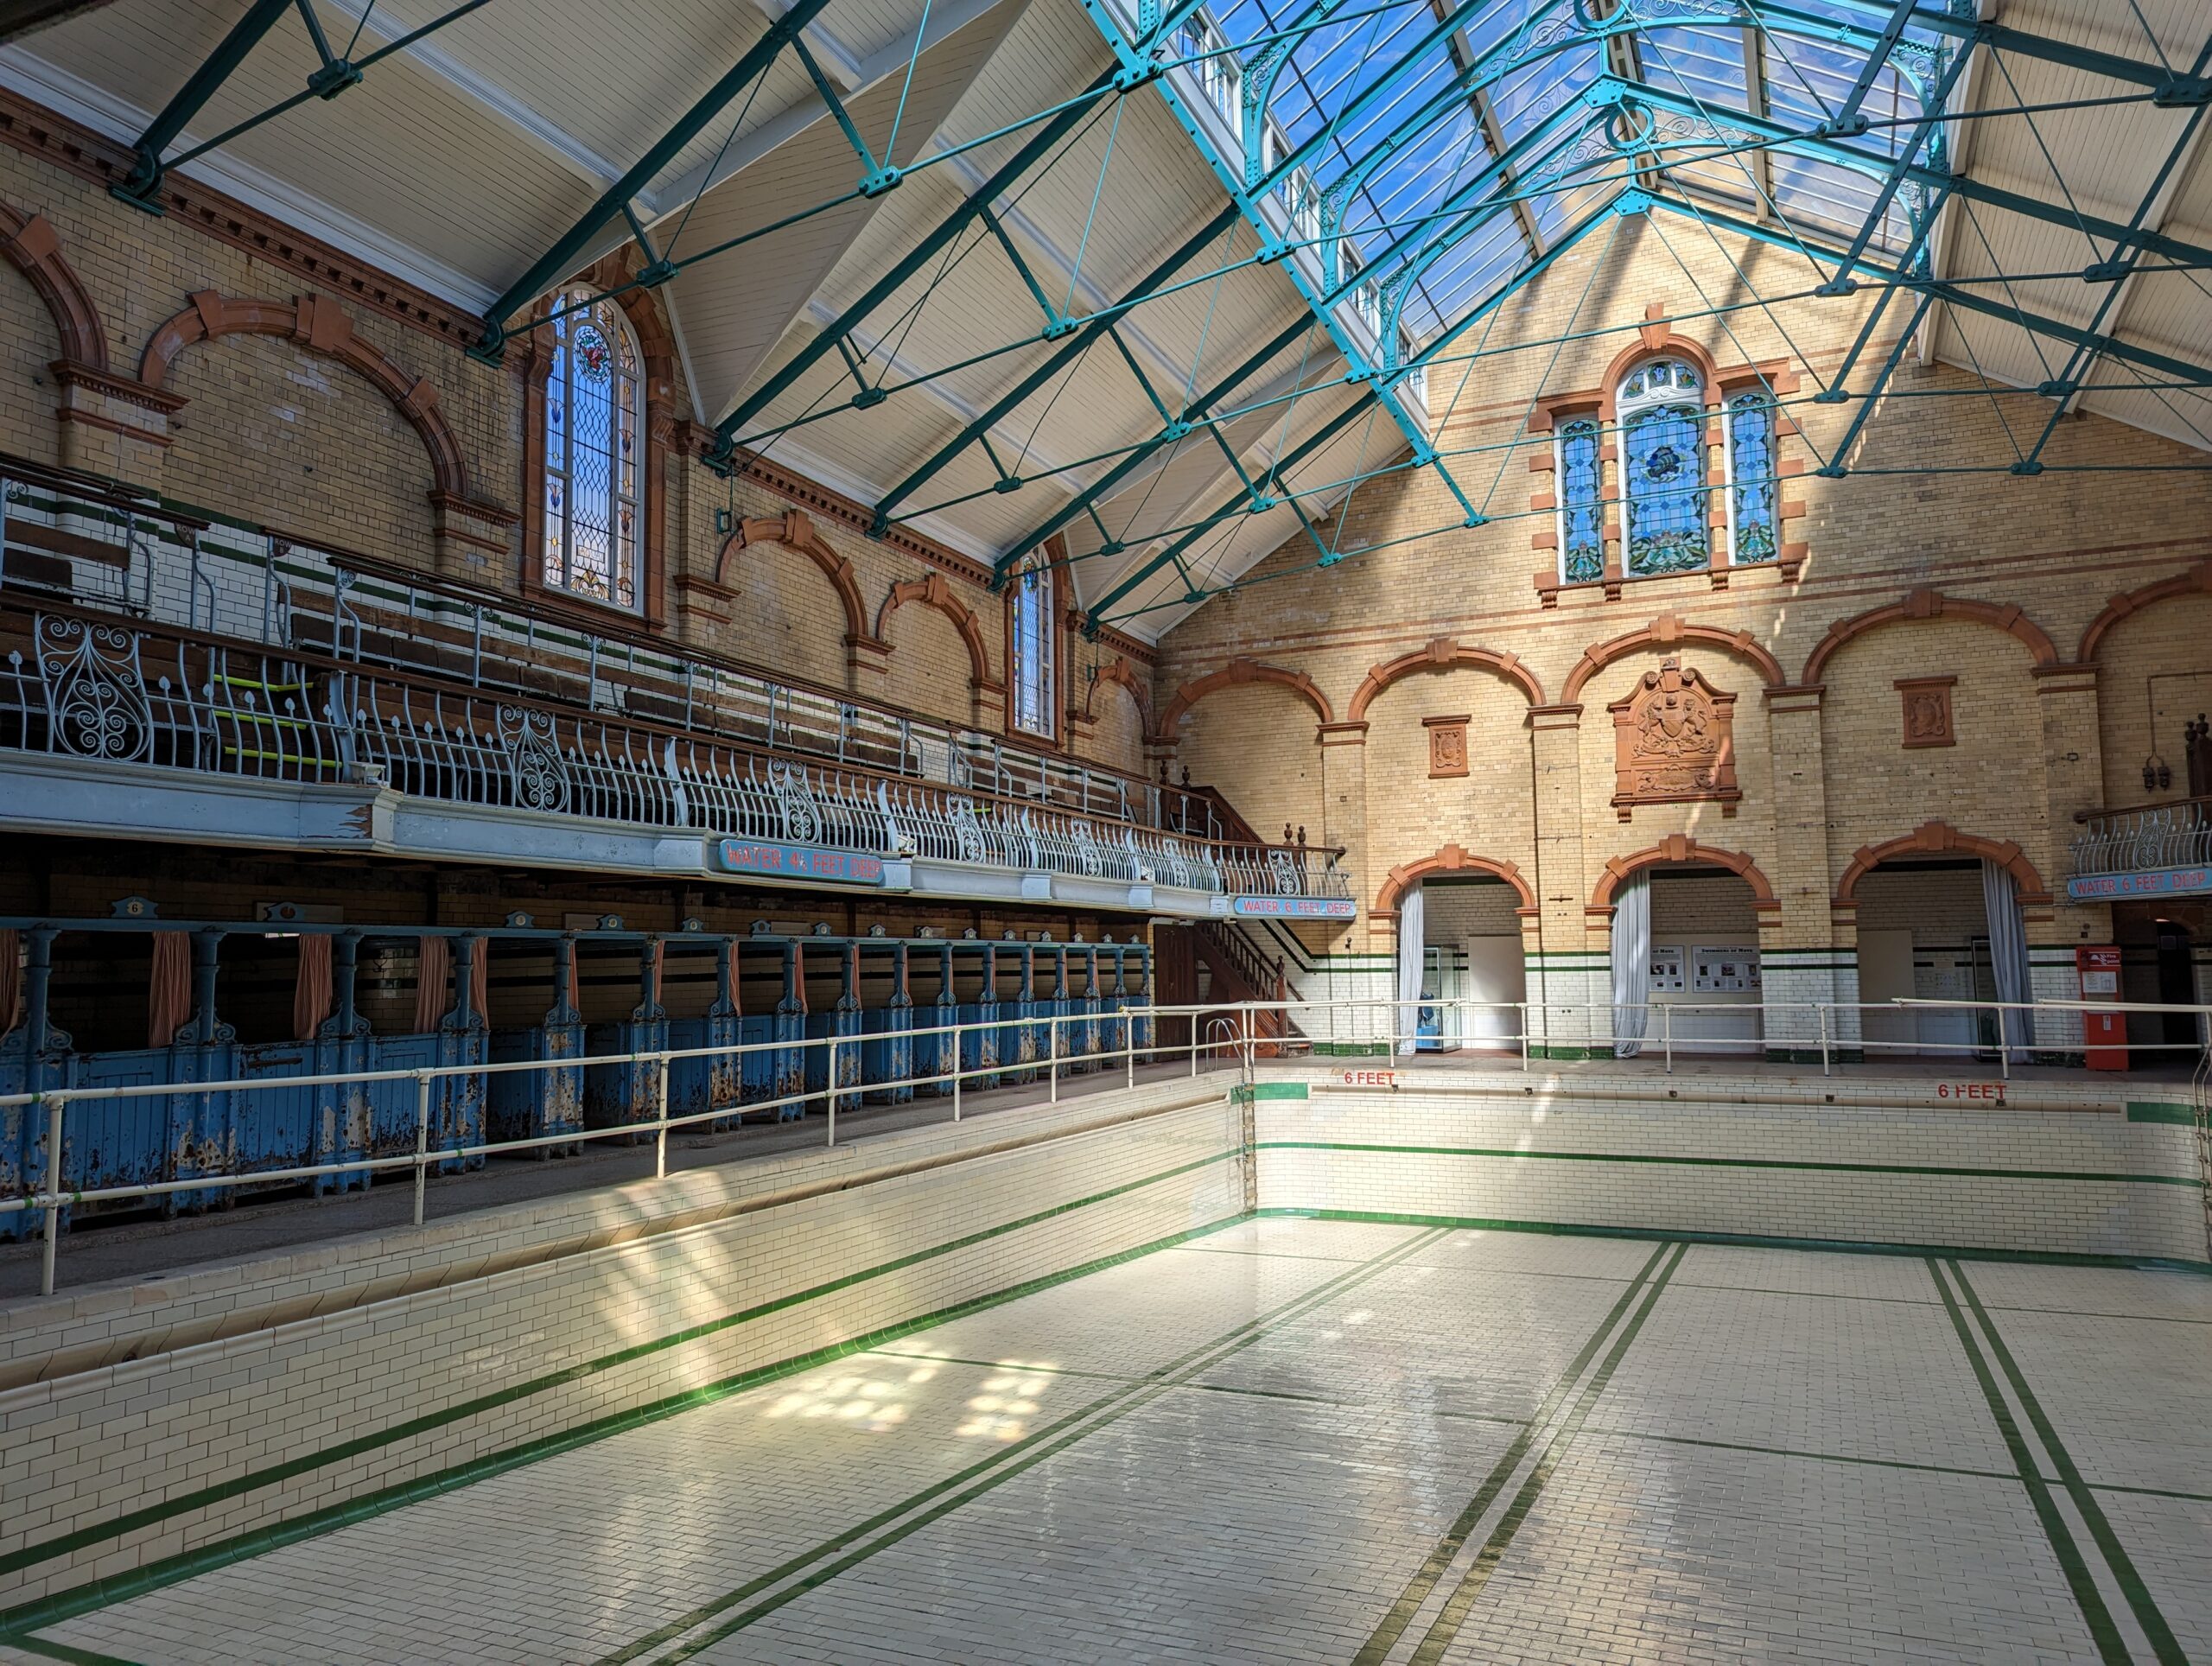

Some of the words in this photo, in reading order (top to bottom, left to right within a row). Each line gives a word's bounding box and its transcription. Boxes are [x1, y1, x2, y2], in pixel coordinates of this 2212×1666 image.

[176, 525, 195, 535] ROW
[275, 538, 292, 548] ROW
[726, 843, 782, 869] WATER
[813, 854, 844, 875] FEET
[850, 856, 882, 880] DEEP
[2075, 878, 2116, 895] WATER
[2122, 877, 2131, 892] 6
[2136, 874, 2164, 891] FEET
[131, 903, 138, 913] 6
[1243, 900, 1278, 913] WATER
[1285, 901, 1292, 912] 6
[1298, 901, 1320, 914] FEET
[1326, 902, 1351, 914] DEEP
[1344, 1071, 1352, 1084] 6
[1357, 1071, 1395, 1085] FEET
[1938, 1084, 1948, 1098] 6
[1955, 1084, 2007, 1099] FEET
